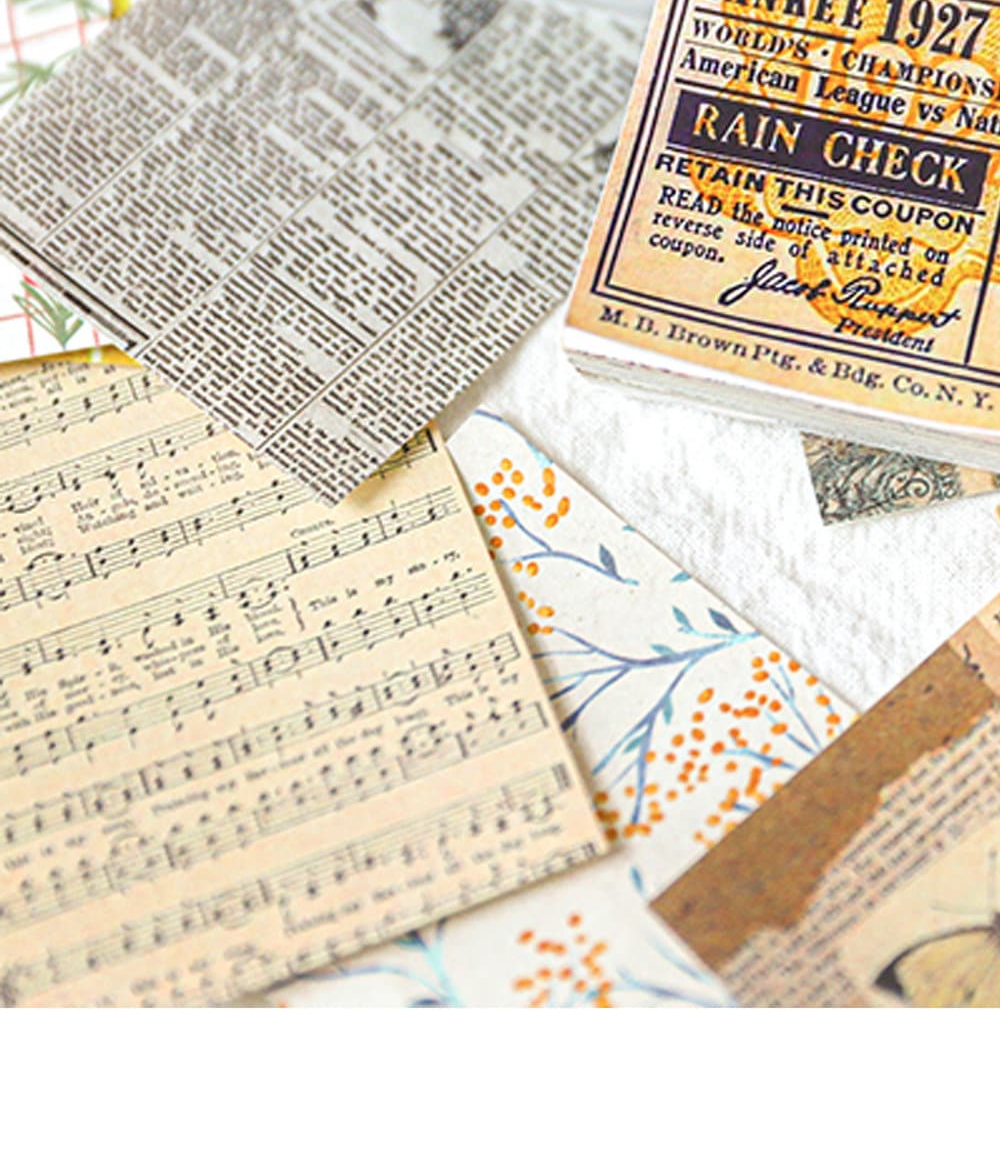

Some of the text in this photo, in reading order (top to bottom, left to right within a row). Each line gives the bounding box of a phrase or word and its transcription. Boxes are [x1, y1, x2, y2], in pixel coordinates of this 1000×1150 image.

[692, 17, 811, 61] WORLD'S
[680, 46, 800, 93] American
[814, 75, 907, 114] League
[917, 100, 946, 123] vs
[692, 102, 969, 195] RAIN CHECK
[654, 153, 975, 235] RETAIN THIS COUPON
[657, 184, 950, 264] READ the notice printed on
[648, 232, 726, 264] coupon.
[652, 211, 946, 287] reverse side of attached
[599, 304, 629, 328] M.
[634, 314, 660, 336] B.
[667, 323, 748, 358] Brown
[752, 343, 802, 372] Ptg.
[807, 356, 828, 376] &
[832, 360, 884, 390] Bdg.
[893, 373, 929, 400] Co.
[834, 316, 936, 354] President
